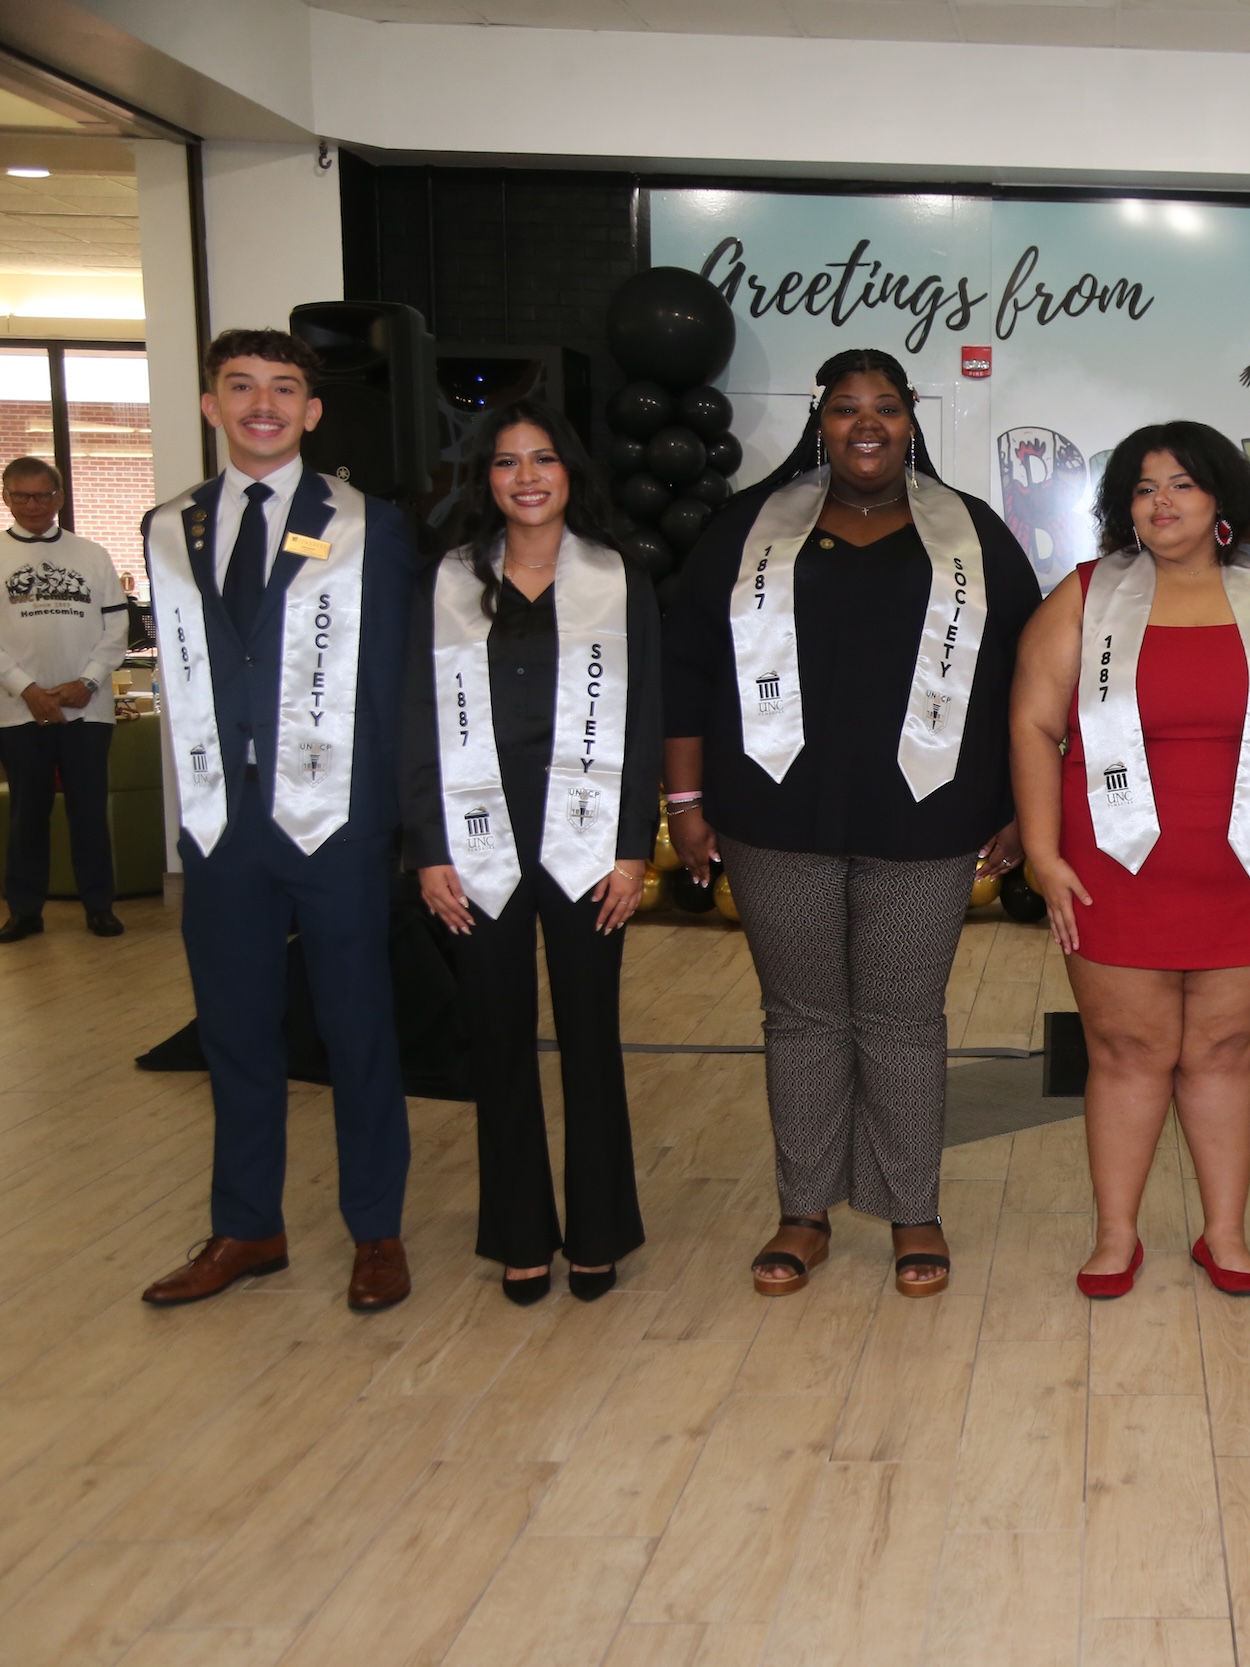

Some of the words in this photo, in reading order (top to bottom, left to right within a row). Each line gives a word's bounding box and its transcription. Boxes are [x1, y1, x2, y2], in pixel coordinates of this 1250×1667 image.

[700, 236, 988, 354] Greetings
[996, 245, 1155, 341] from
[754, 545, 772, 610] 1887
[21, 607, 85, 618] Homecoming
[174, 607, 192, 683] 1887
[940, 557, 967, 678] SOCIETY
[309, 593, 332, 727] SOCIETY
[1098, 634, 1113, 703] 1887
[455, 672, 470, 747] 1887
[580, 643, 604, 774] SOCIETY
[758, 700, 785, 713] UNC
[193, 774, 213, 785] UNC
[1106, 790, 1133, 804] UNC
[467, 835, 495, 849] UNC
